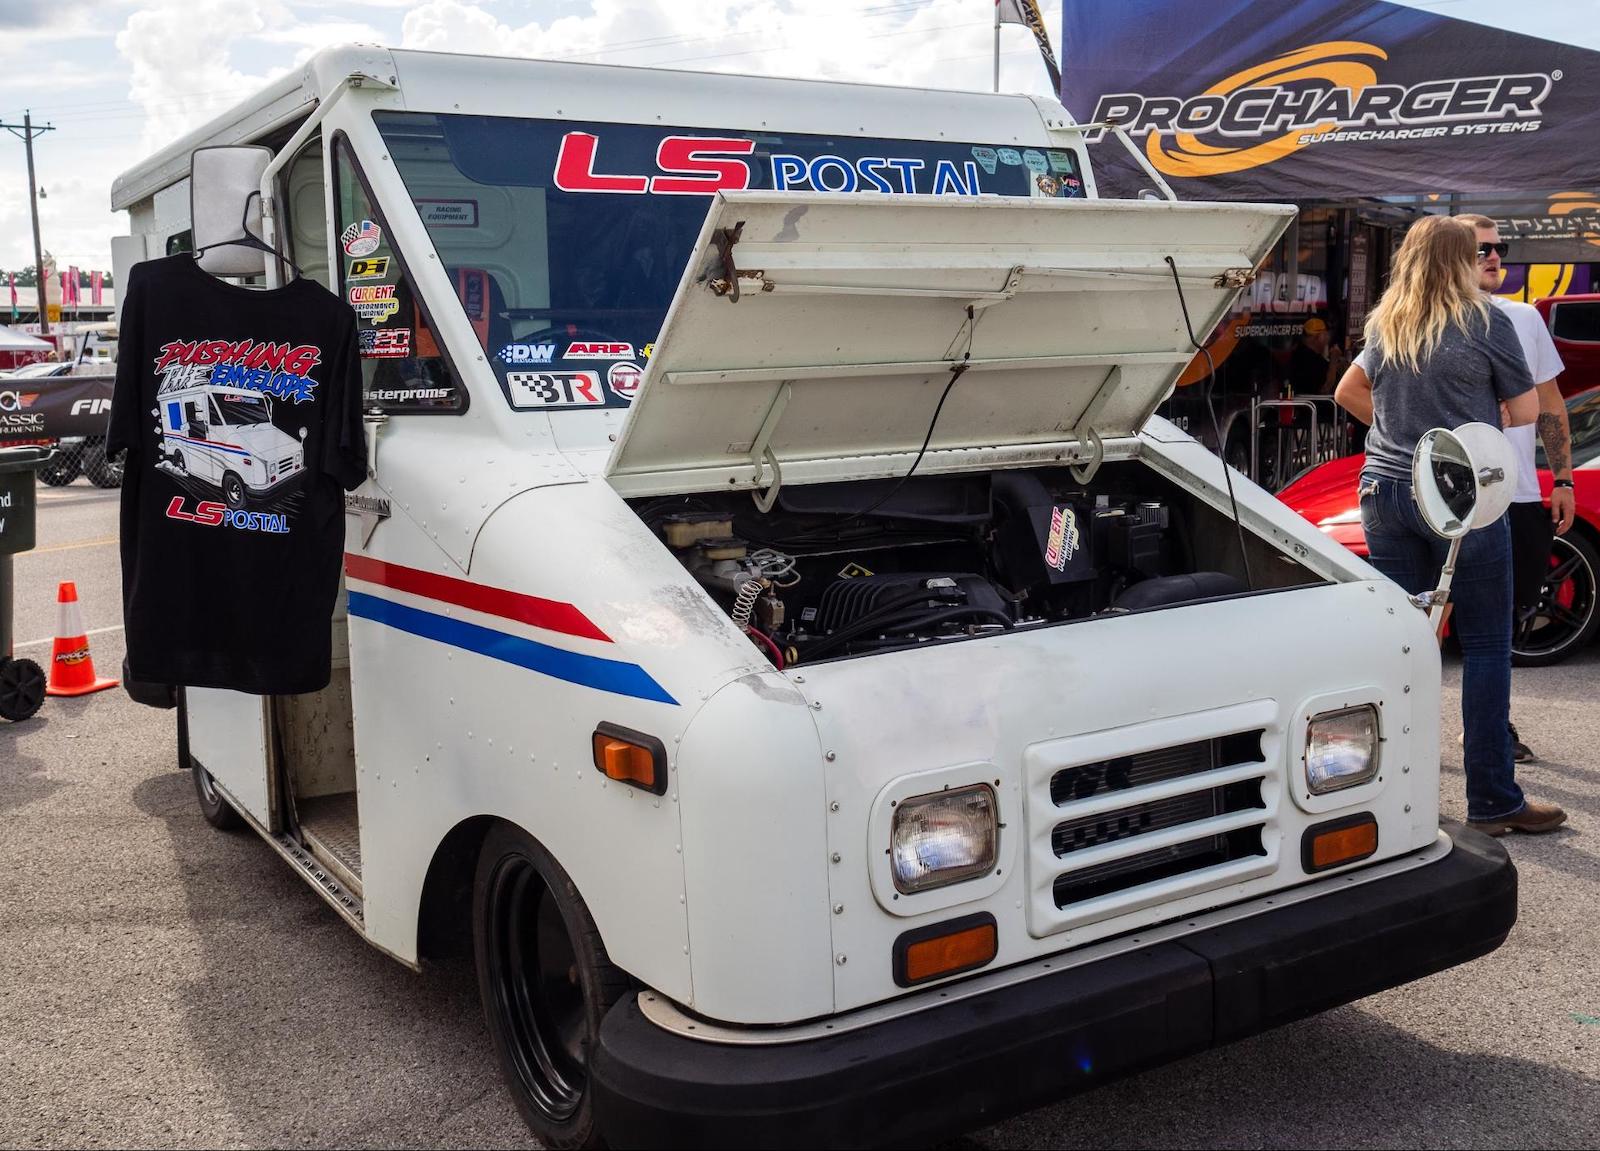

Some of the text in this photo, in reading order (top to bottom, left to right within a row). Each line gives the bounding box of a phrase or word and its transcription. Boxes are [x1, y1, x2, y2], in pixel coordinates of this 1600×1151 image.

[1084, 72, 1553, 144] PROCHARGER
[1297, 120, 1541, 145] SUPERCHARGER SYSTEMS
[553, 131, 756, 194] LS
[350, 286, 395, 303] CURRENT
[154, 338, 321, 376] PUSHING
[512, 345, 556, 359] DW
[568, 344, 629, 353] ARP
[157, 362, 318, 404] THE ENVELOPE
[527, 374, 599, 403] BTR
[166, 496, 290, 533] LS POSTAL
